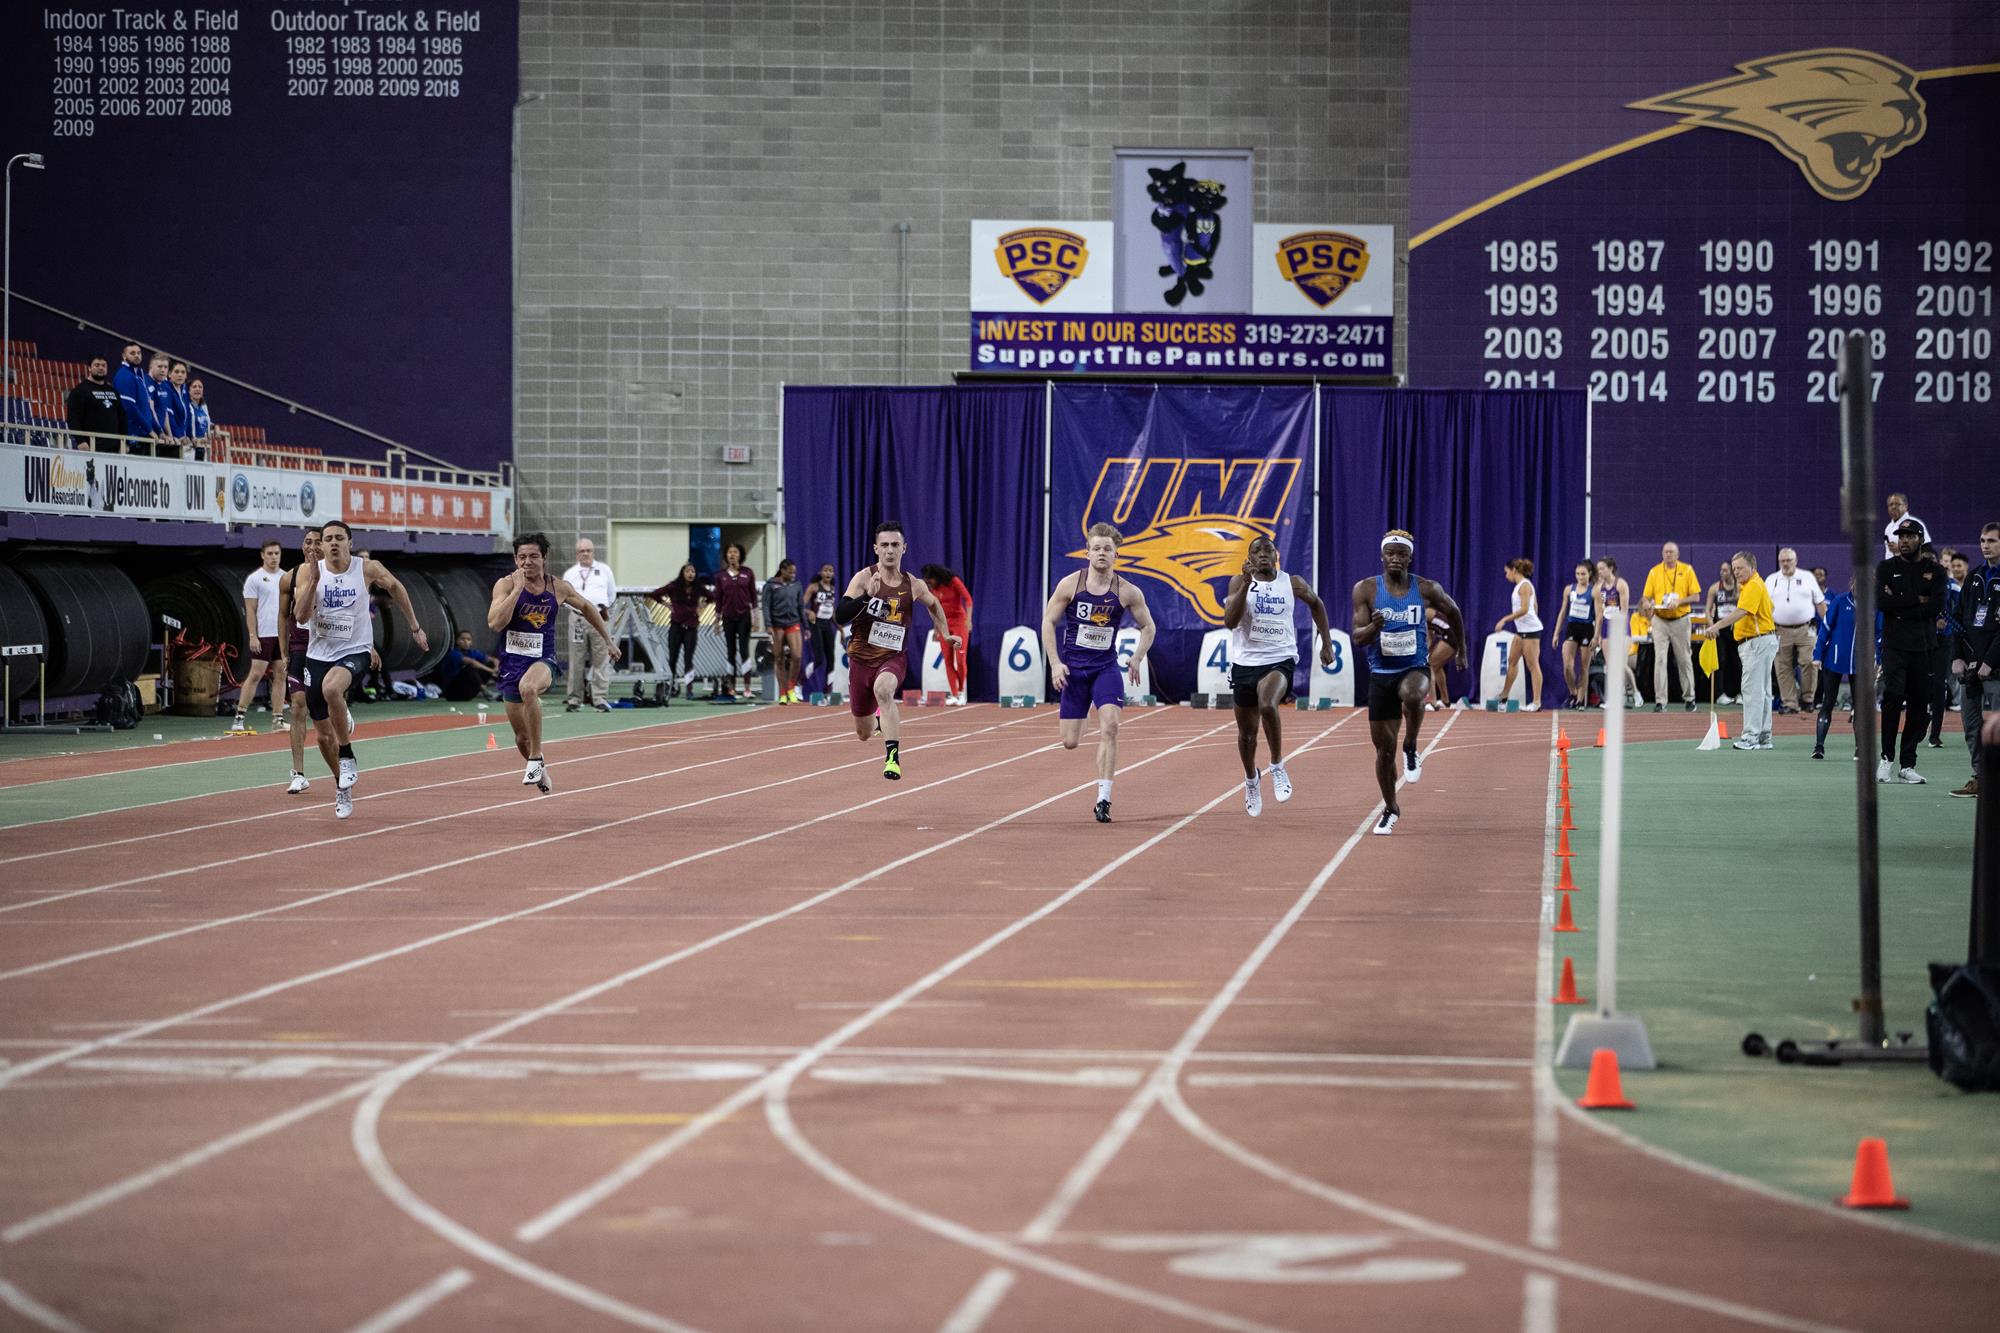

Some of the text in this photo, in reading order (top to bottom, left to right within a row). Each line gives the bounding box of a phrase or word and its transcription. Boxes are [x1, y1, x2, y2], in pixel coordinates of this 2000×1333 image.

[44, 9, 239, 31] Indoor Track & Field
[270, 10, 480, 32] Outdoor Track & Field
[54, 36, 231, 54] 1984 1985 1986 1988
[285, 37, 463, 55] 1982 1983 1984 1986
[54, 57, 232, 75] 1990 1995 1996 2000
[287, 58, 464, 76] 1995 1998 2000 2005
[53, 77, 230, 96] 2001 2002 2003 2004
[287, 79, 460, 98] 2007 2008 2009 2018
[54, 98, 232, 117] 2005 2006 2007 2008
[53, 119, 95, 137] 2009
[1005, 241, 1080, 271] PSC
[1287, 243, 1360, 274] PSC
[1485, 240, 1992, 272] 1985 1987 1990 1991 1992
[1485, 284, 1991, 316] 1993 1994 1995 1996 2001
[980, 321, 1384, 345] INVEST IN OUR SUCCESS 319-273-2471
[1484, 327, 1991, 359] 2003 2005 2007 208 2010
[978, 344, 1385, 369] SupportThePanthers.com
[1590, 371, 1667, 402] 2014
[1698, 371, 1775, 402] 2015
[1807, 371, 1884, 402] 207
[1915, 371, 1991, 402] 2018
[25, 456, 50, 503] UNI
[105, 464, 158, 508] Welcome
[160, 477, 170, 509] to
[186, 474, 205, 511] UNI
[51, 487, 86, 506] Association
[1081, 457, 1303, 536] UNI
[324, 585, 357, 602] Indiana
[1250, 580, 1260, 593] 2
[322, 597, 356, 609] State
[869, 599, 880, 615] 4
[1254, 602, 1285, 616] State
[1256, 593, 1286, 608] Indiana
[1078, 603, 1089, 619] 3
[1410, 606, 1418, 624] 1
[318, 621, 352, 632] MOOTHERY
[873, 629, 902, 641] PAPPER
[1083, 632, 1107, 642] SMITH
[1008, 636, 1032, 672] 6
[1118, 638, 1136, 673] 5
[1206, 639, 1231, 673] 4
[1496, 642, 1508, 676] 1
